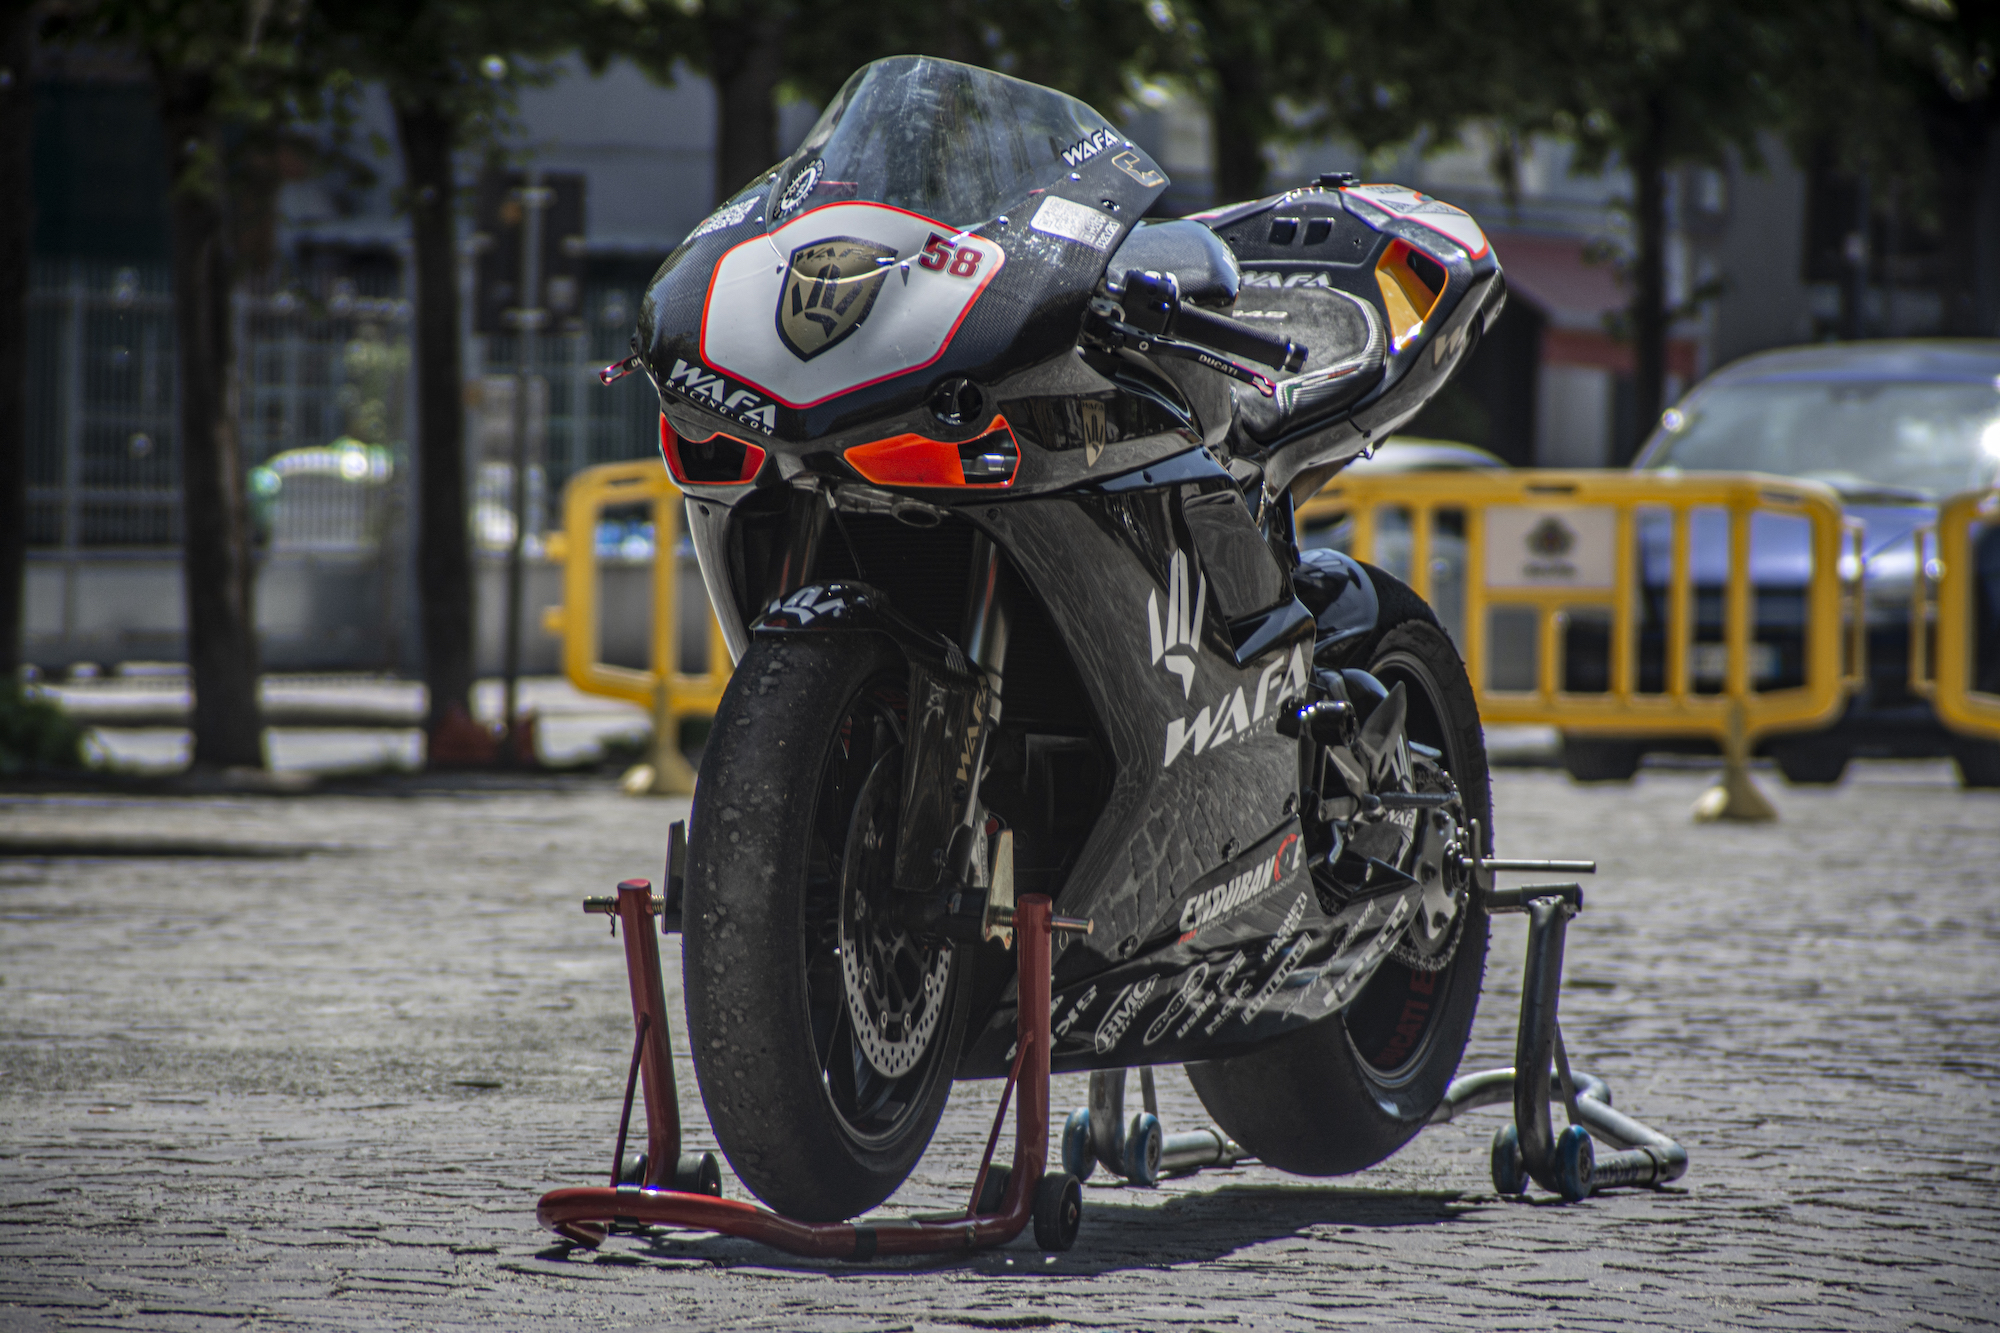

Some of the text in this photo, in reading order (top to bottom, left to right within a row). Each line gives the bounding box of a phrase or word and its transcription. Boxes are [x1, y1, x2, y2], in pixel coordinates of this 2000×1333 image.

[1062, 129, 1119, 167] WAFA
[919, 231, 985, 279] 58
[670, 358, 776, 429] WAFA
[1199, 354, 1238, 376] DUCATI
[1163, 643, 1307, 768] WAFA
[1097, 980, 1152, 1047] BMC
